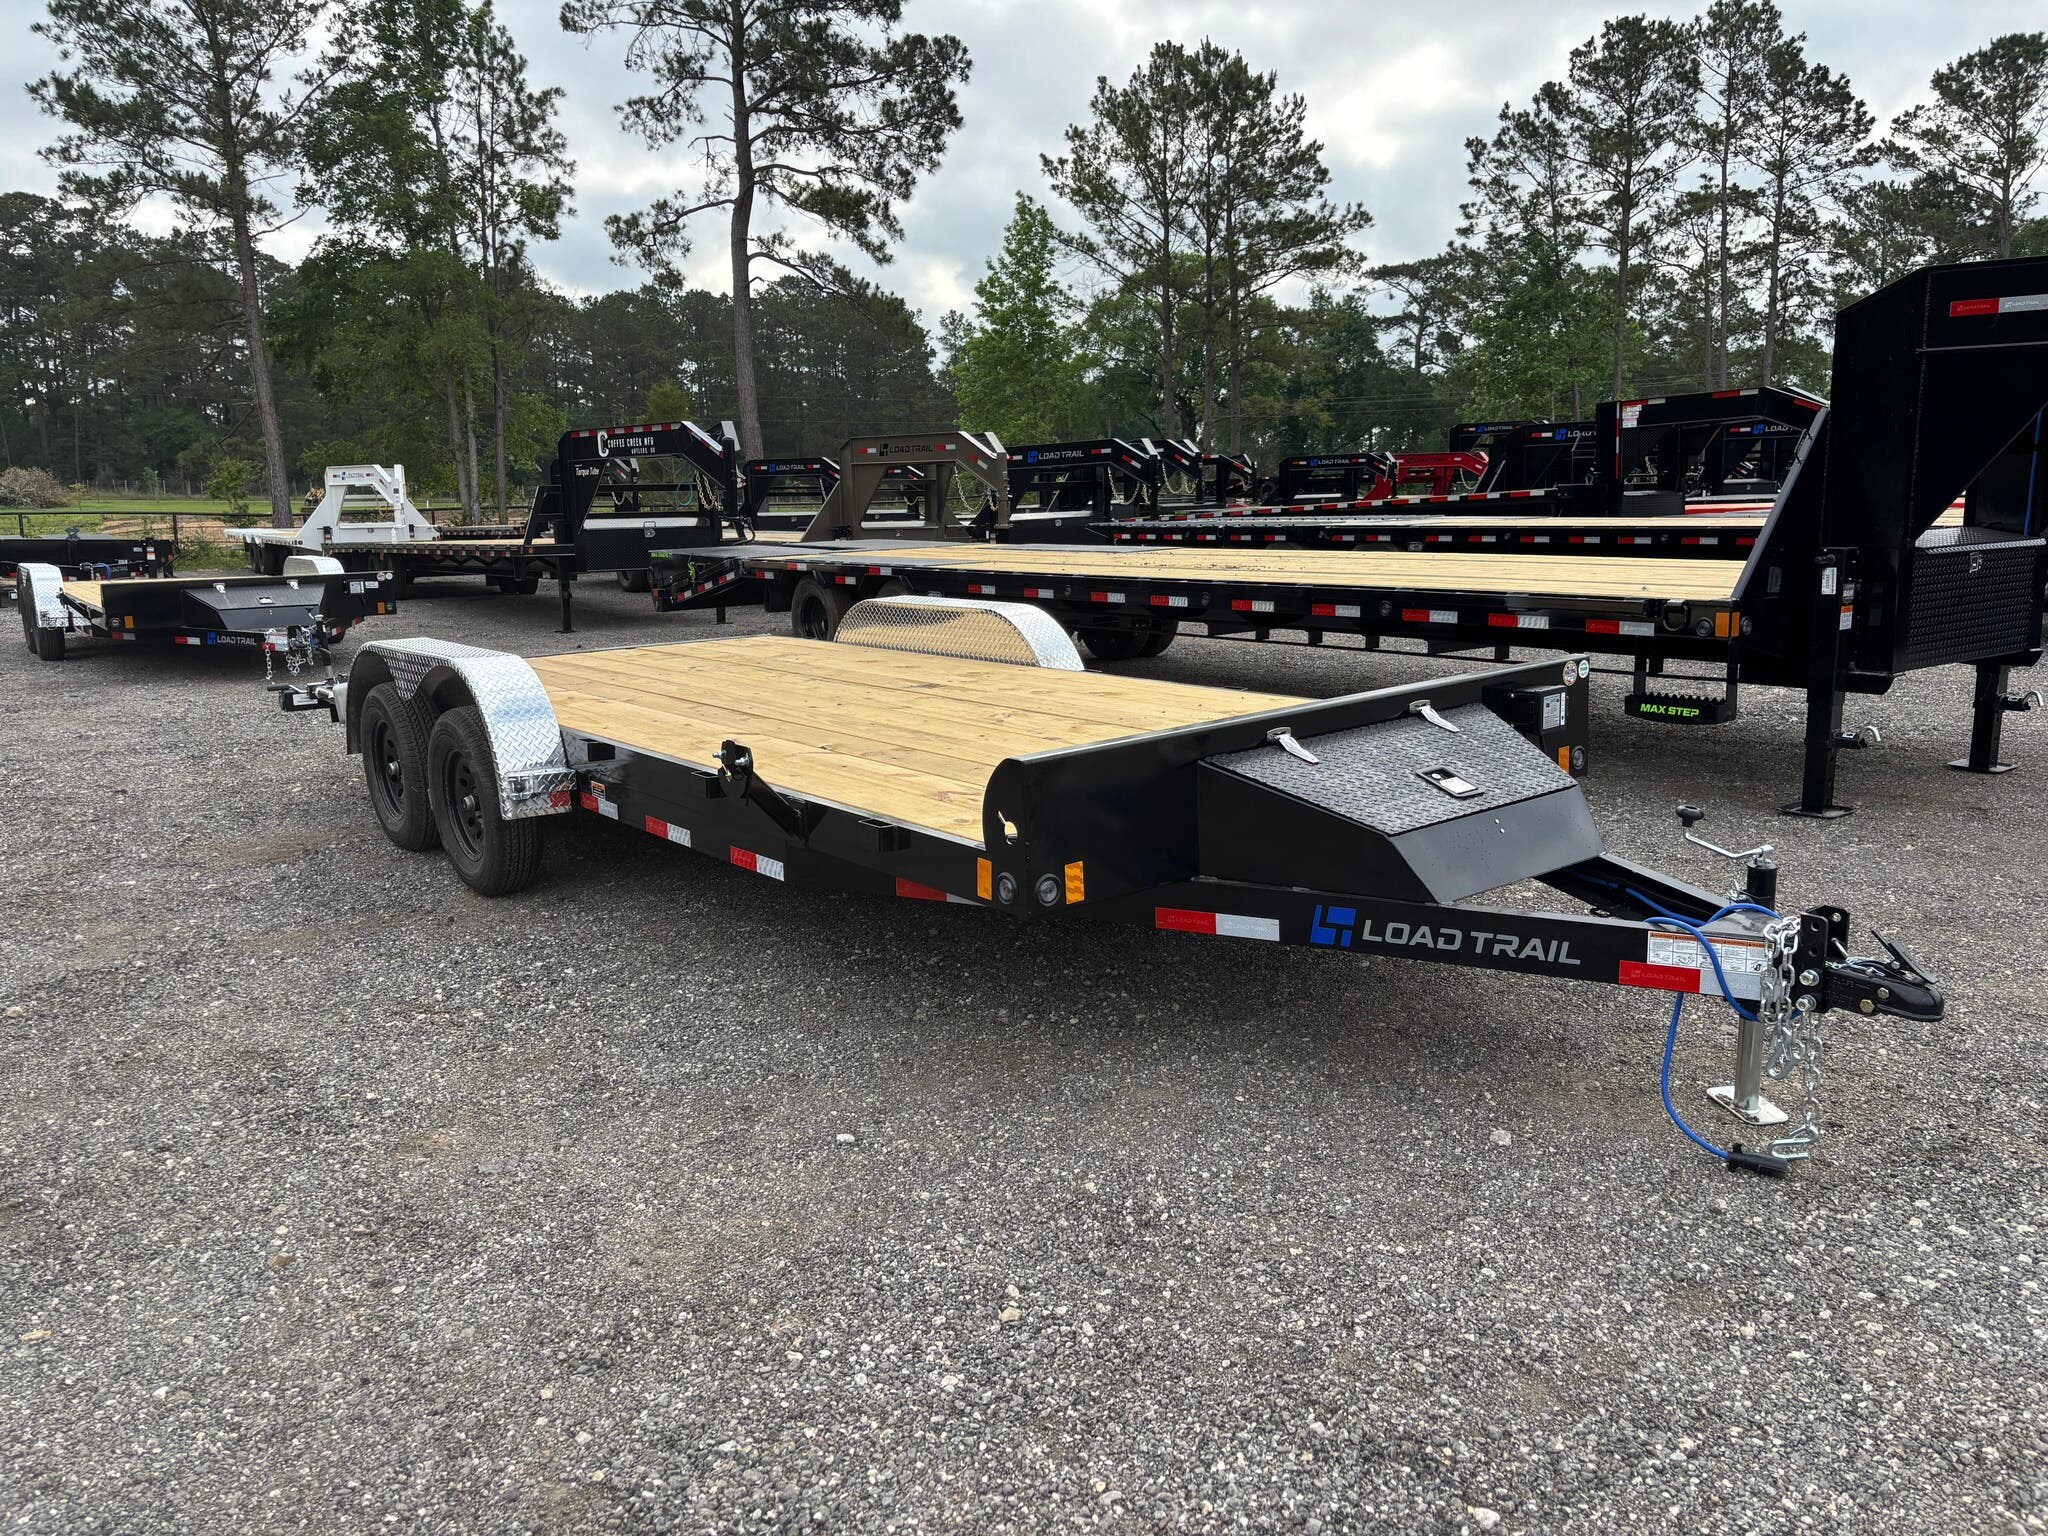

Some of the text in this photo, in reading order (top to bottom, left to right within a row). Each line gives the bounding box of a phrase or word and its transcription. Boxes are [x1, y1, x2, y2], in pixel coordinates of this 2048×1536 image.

[607, 436, 654, 448] COFFEE CREEK MFG
[889, 444, 933, 454] LOAD TRAIL
[1038, 450, 1084, 460] LOAD TRAIL
[217, 635, 257, 646] LOAD TRAIL
[1640, 703, 1700, 717] MAX STEP
[1362, 919, 1581, 966] LOAD TRAIL
[1641, 971, 1663, 980] LOAD
[1663, 973, 1687, 983] TRAIL
